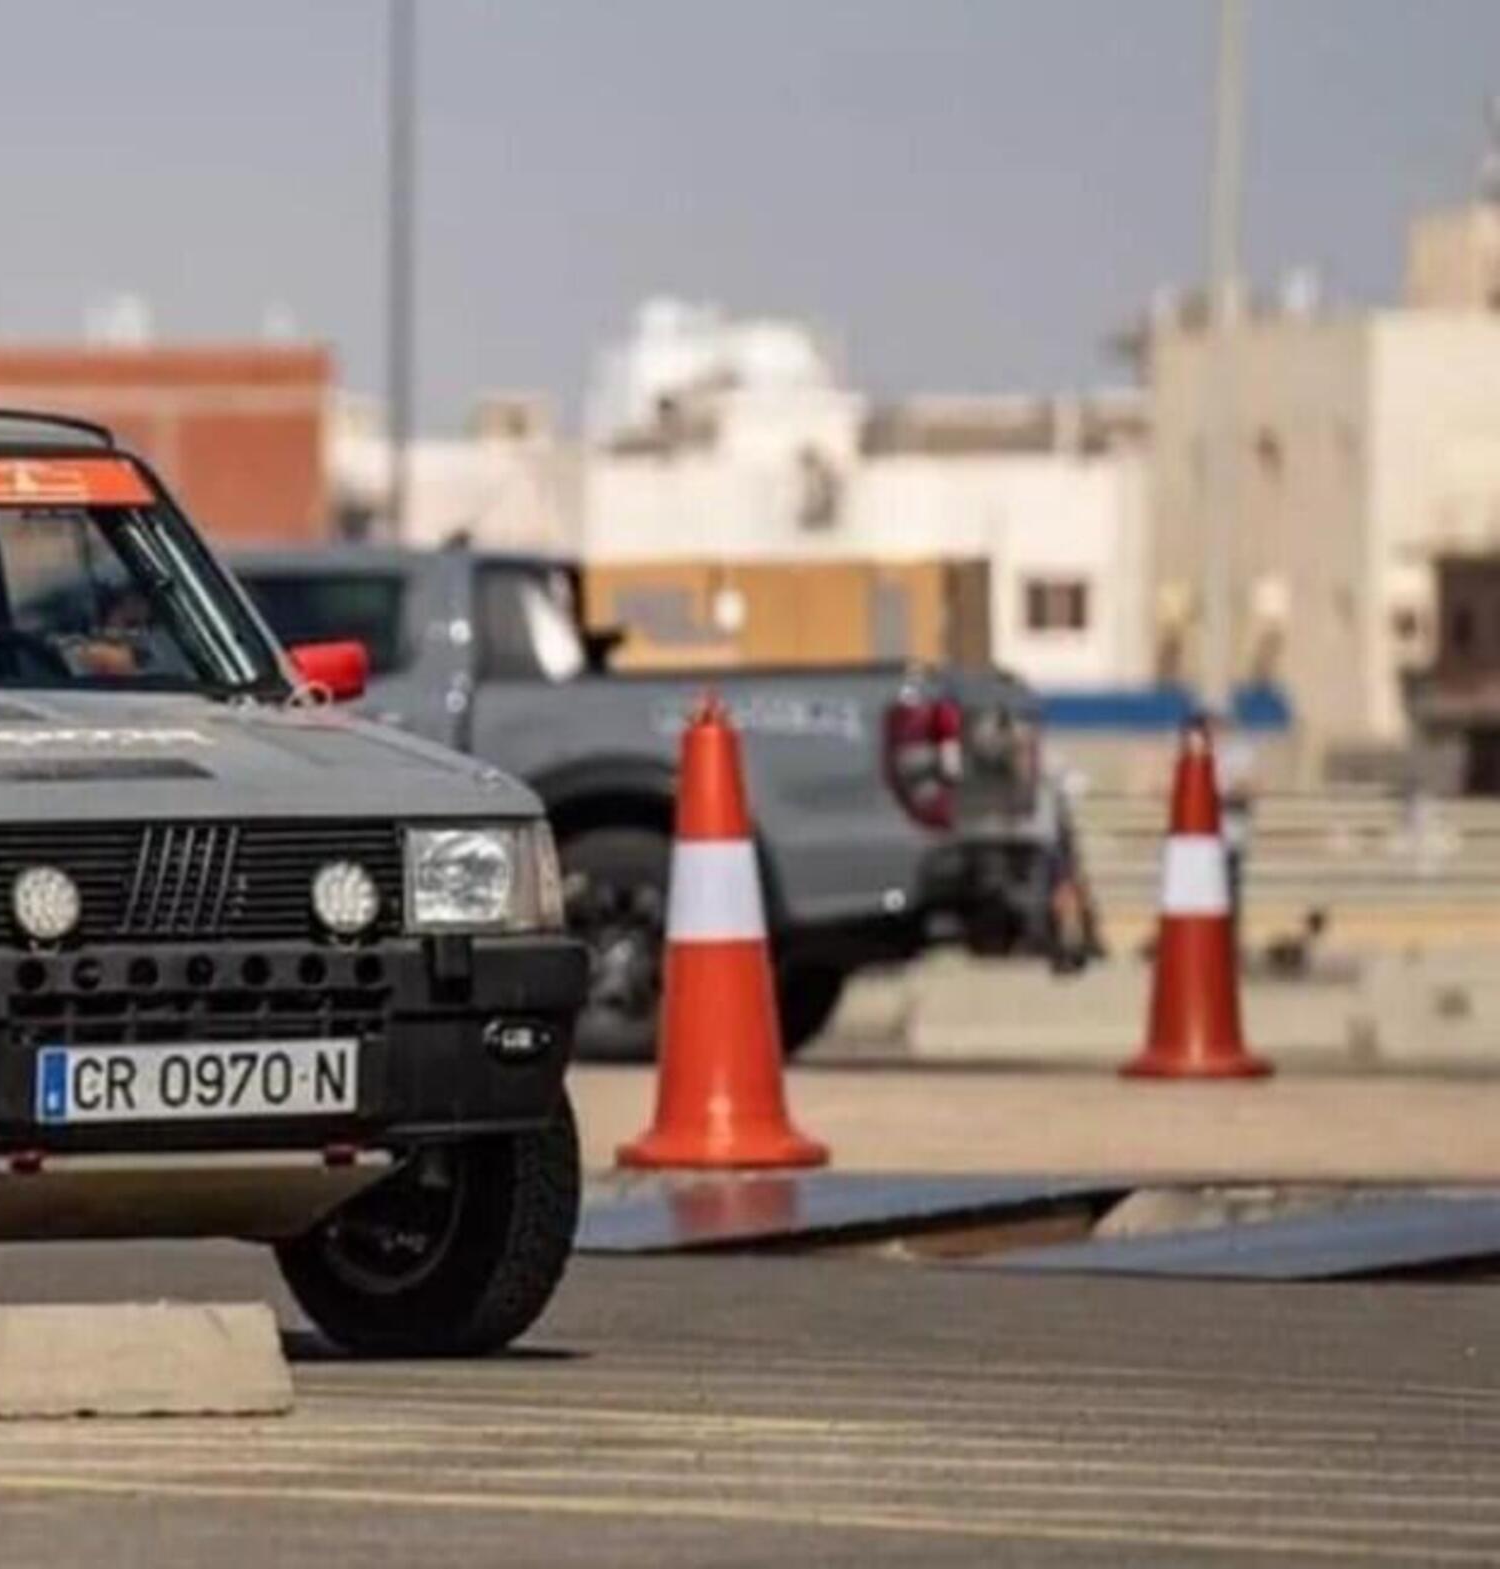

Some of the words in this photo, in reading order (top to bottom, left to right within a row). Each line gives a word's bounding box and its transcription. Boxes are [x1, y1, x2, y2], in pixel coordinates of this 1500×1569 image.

[73, 1055, 137, 1111] CR
[159, 1051, 293, 1108] 0970
[315, 1049, 347, 1104] N
